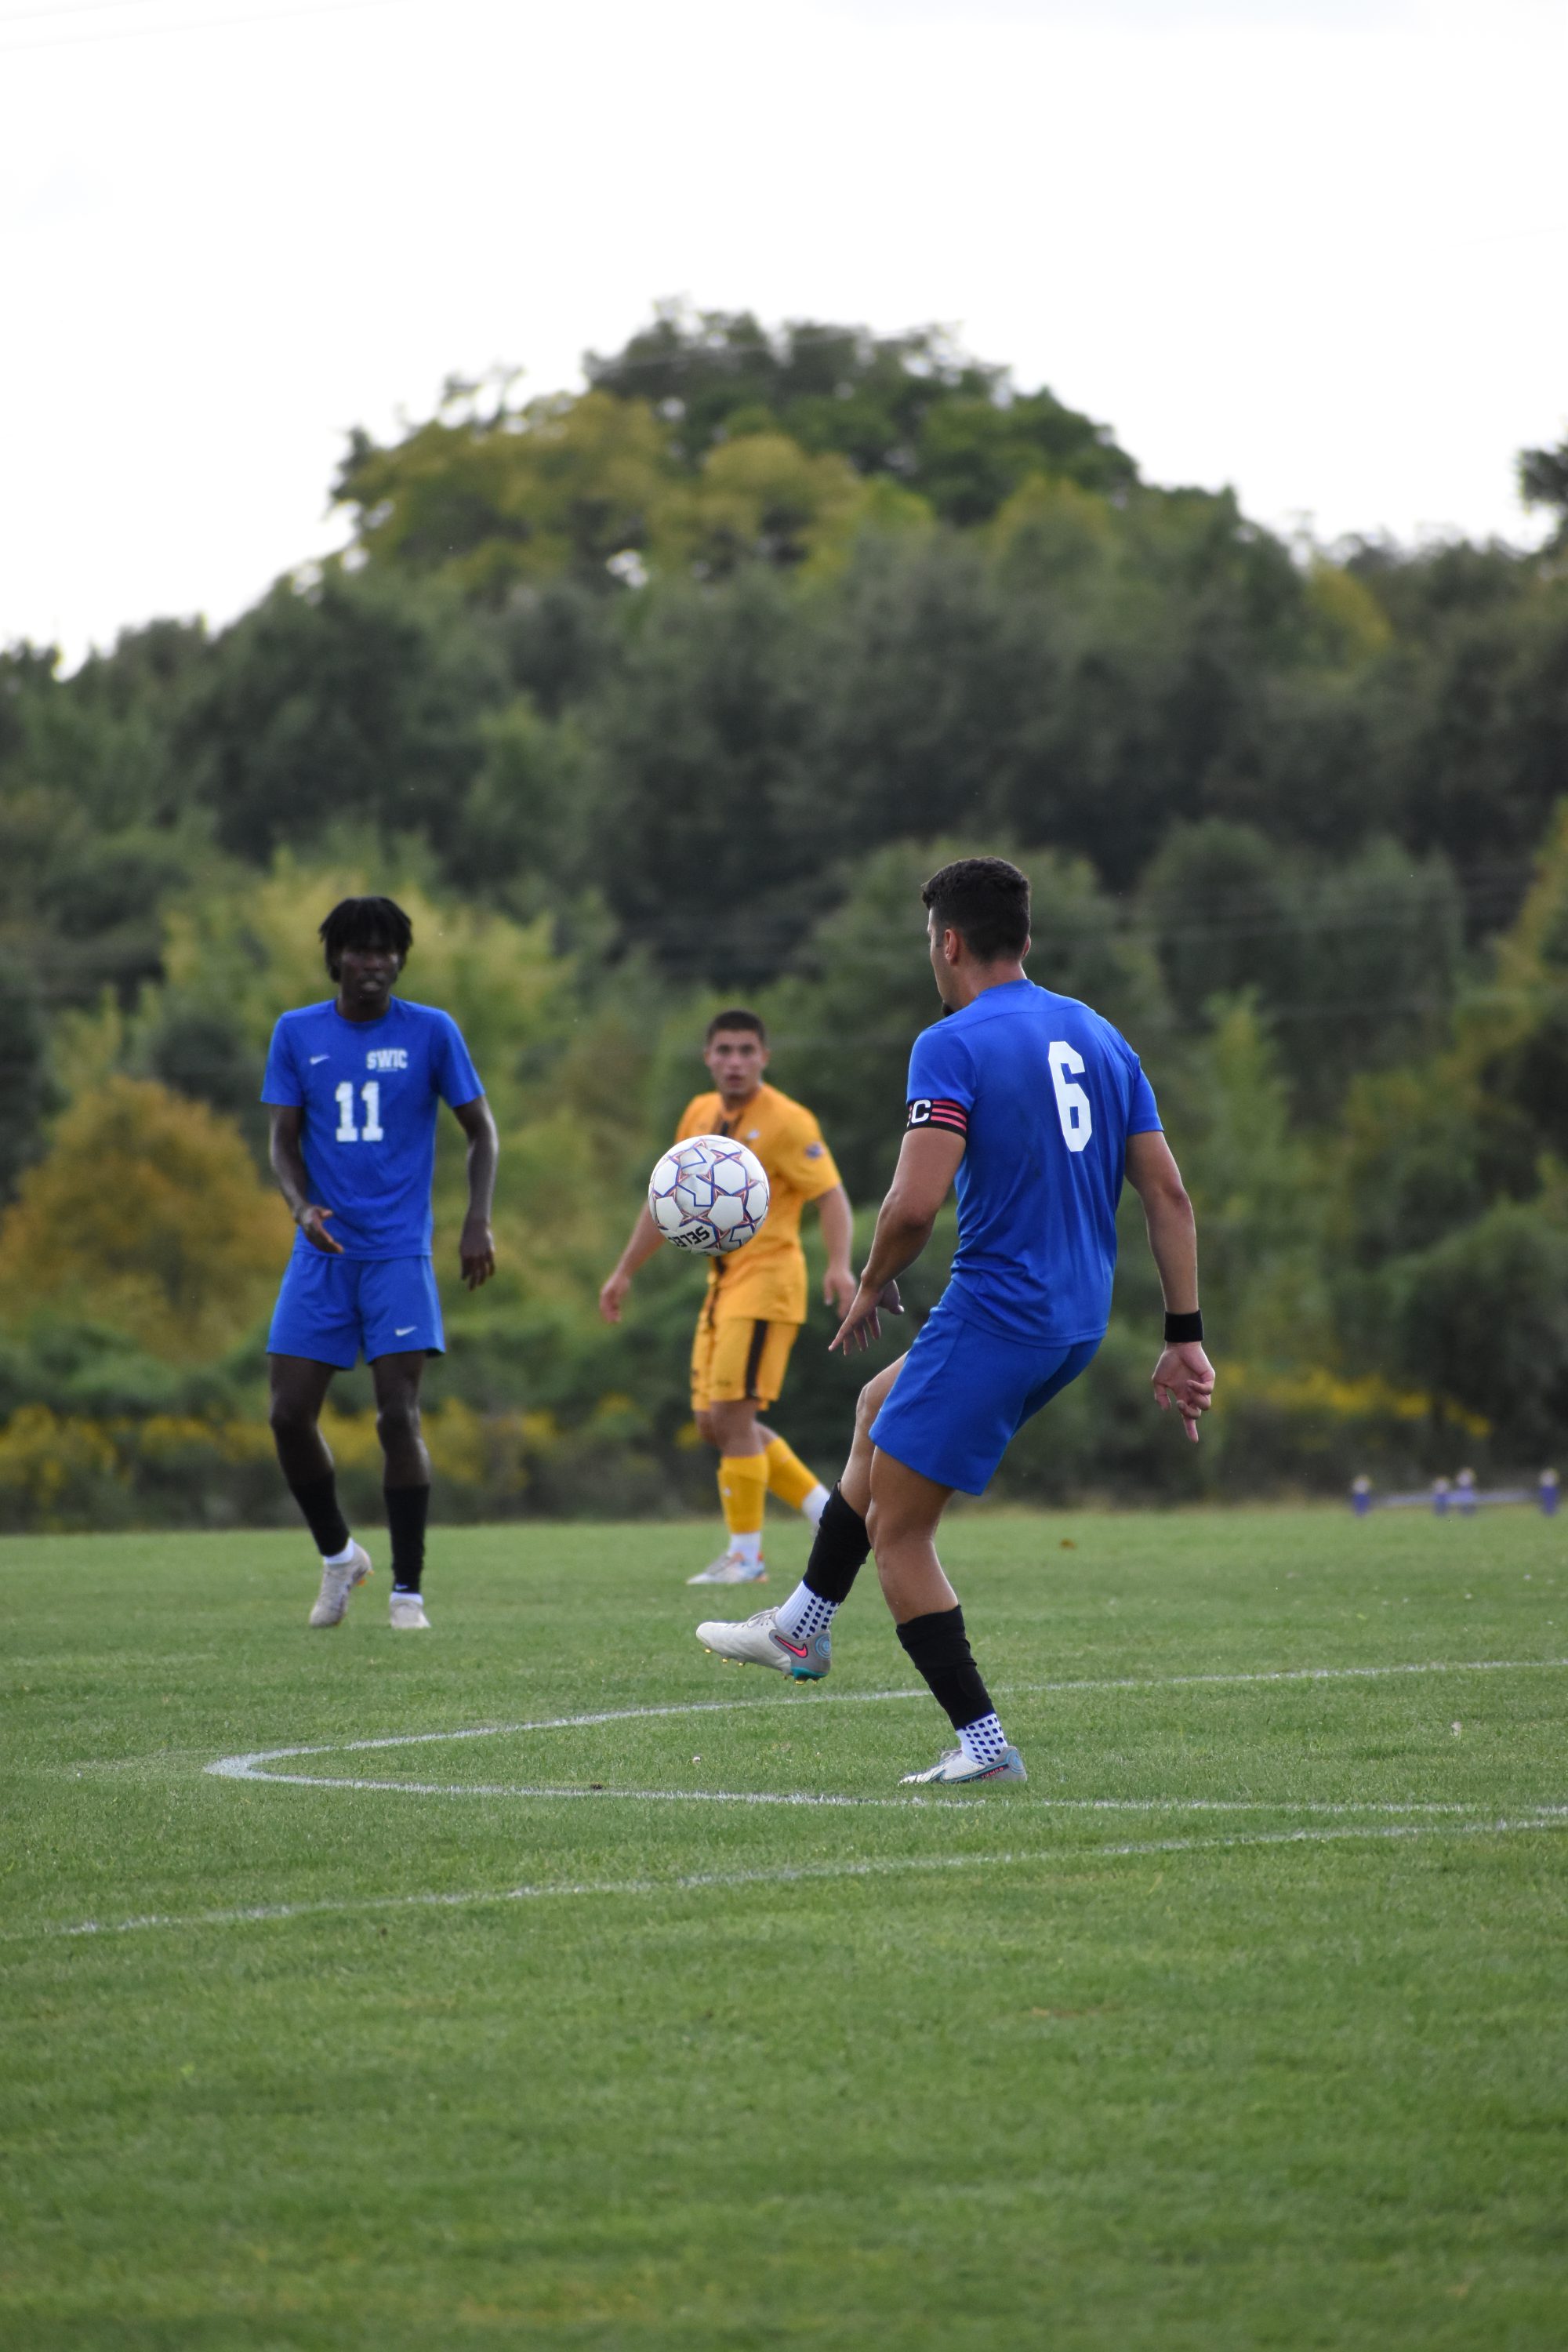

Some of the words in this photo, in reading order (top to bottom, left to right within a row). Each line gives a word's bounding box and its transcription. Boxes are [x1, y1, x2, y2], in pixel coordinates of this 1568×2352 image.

[367, 1049, 408, 1069] SWIC
[336, 1082, 383, 1142] 11
[911, 1099, 931, 1123] C
[1048, 1041, 1092, 1152] 6
